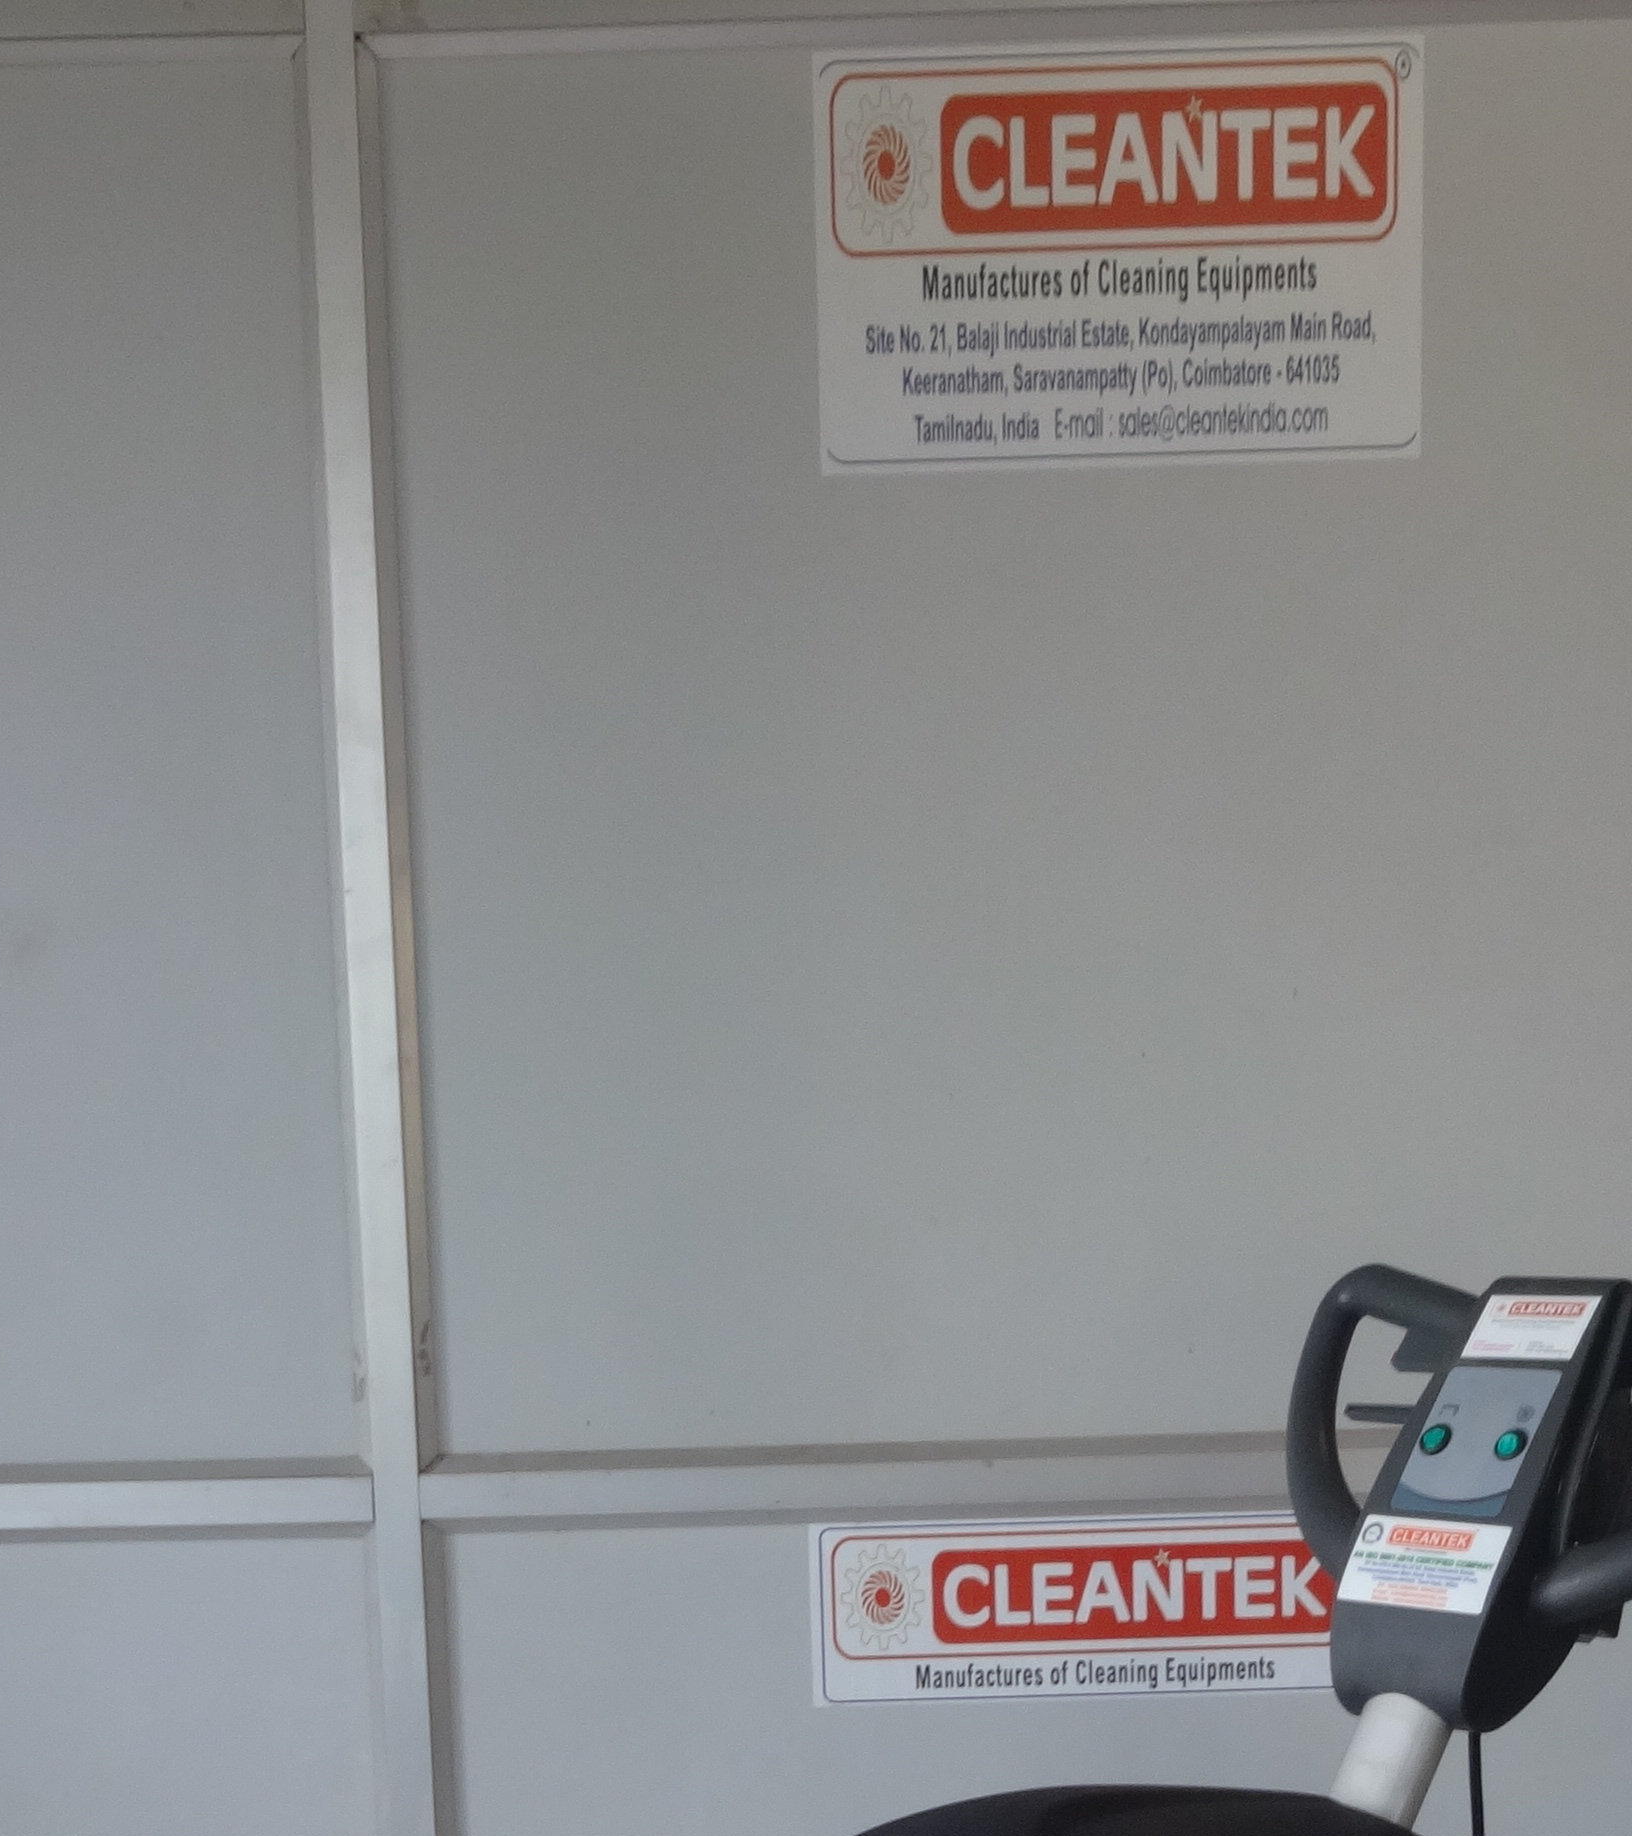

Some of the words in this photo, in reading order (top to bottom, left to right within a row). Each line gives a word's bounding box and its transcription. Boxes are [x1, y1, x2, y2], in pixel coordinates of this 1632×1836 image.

[953, 105, 1376, 211] CLEANTEK
[923, 262, 1063, 301] Manufactures
[1068, 260, 1091, 295] of
[1098, 257, 1189, 301] Cleaning
[1197, 256, 1317, 301] Equipments
[865, 324, 895, 354] Site
[900, 323, 925, 354] No.
[930, 322, 952, 358] 21,
[957, 320, 999, 358] Balaji
[1004, 319, 1076, 351] Industrial
[1081, 317, 1134, 351] Estate,
[1139, 315, 1285, 352] Kondayampalayam
[1290, 312, 1326, 343] Main
[1331, 309, 1376, 344] Road,
[902, 364, 1009, 397] Keeranatham,
[1013, 362, 1137, 398] Saravanampatty
[1142, 357, 1177, 395] (Po),
[1182, 356, 1272, 388] Coimbatore
[1286, 353, 1341, 386] 641035
[914, 412, 998, 445] Tamilnadu,
[1002, 410, 1040, 440] India
[1054, 407, 1104, 439] E-mail
[1118, 402, 1329, 441] sales@cleantekindia.com
[1512, 1302, 1585, 1315] CLEANTEK
[1392, 1528, 1470, 1549] CLEANTEK
[943, 1555, 1328, 1628] CLEANTEK
[915, 1662, 1044, 1691] Manufactures
[1050, 1660, 1069, 1686] of
[1075, 1657, 1159, 1689] Cleaning
[1166, 1655, 1276, 1686] Equipments
